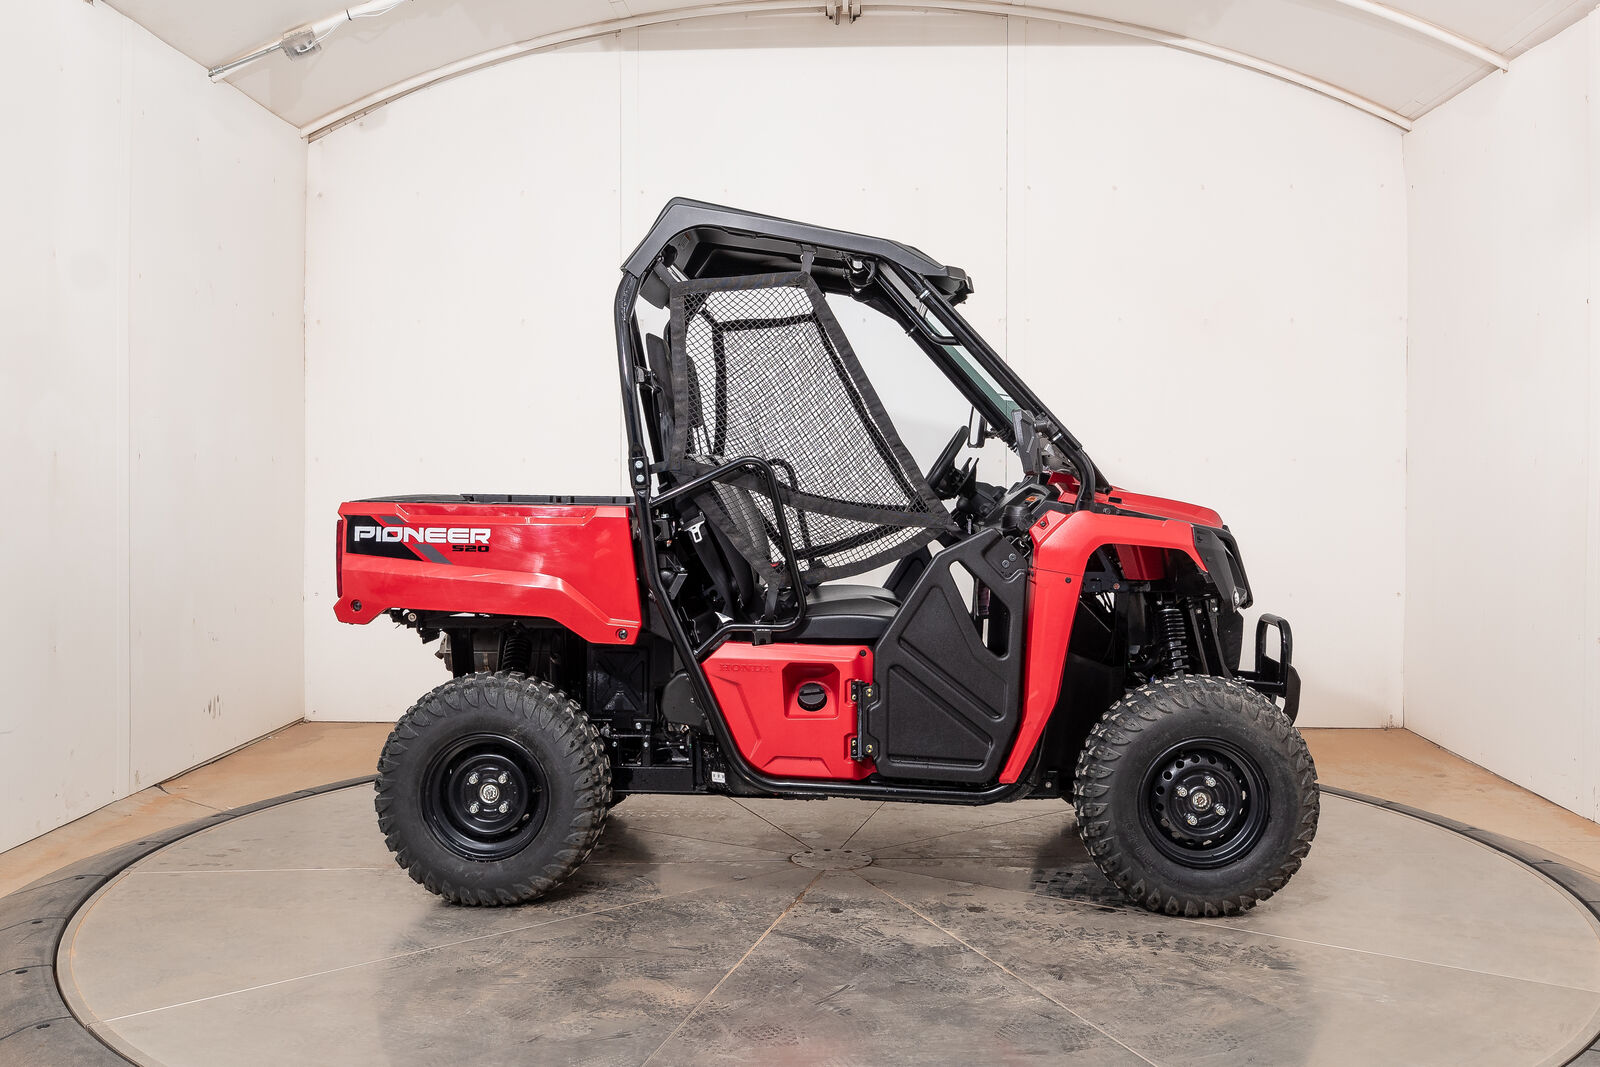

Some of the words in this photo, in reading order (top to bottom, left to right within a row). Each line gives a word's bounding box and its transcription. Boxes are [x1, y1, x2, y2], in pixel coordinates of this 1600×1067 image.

[354, 526, 491, 544] PIONEER
[452, 545, 490, 553] 520
[719, 664, 772, 672] HONDA
